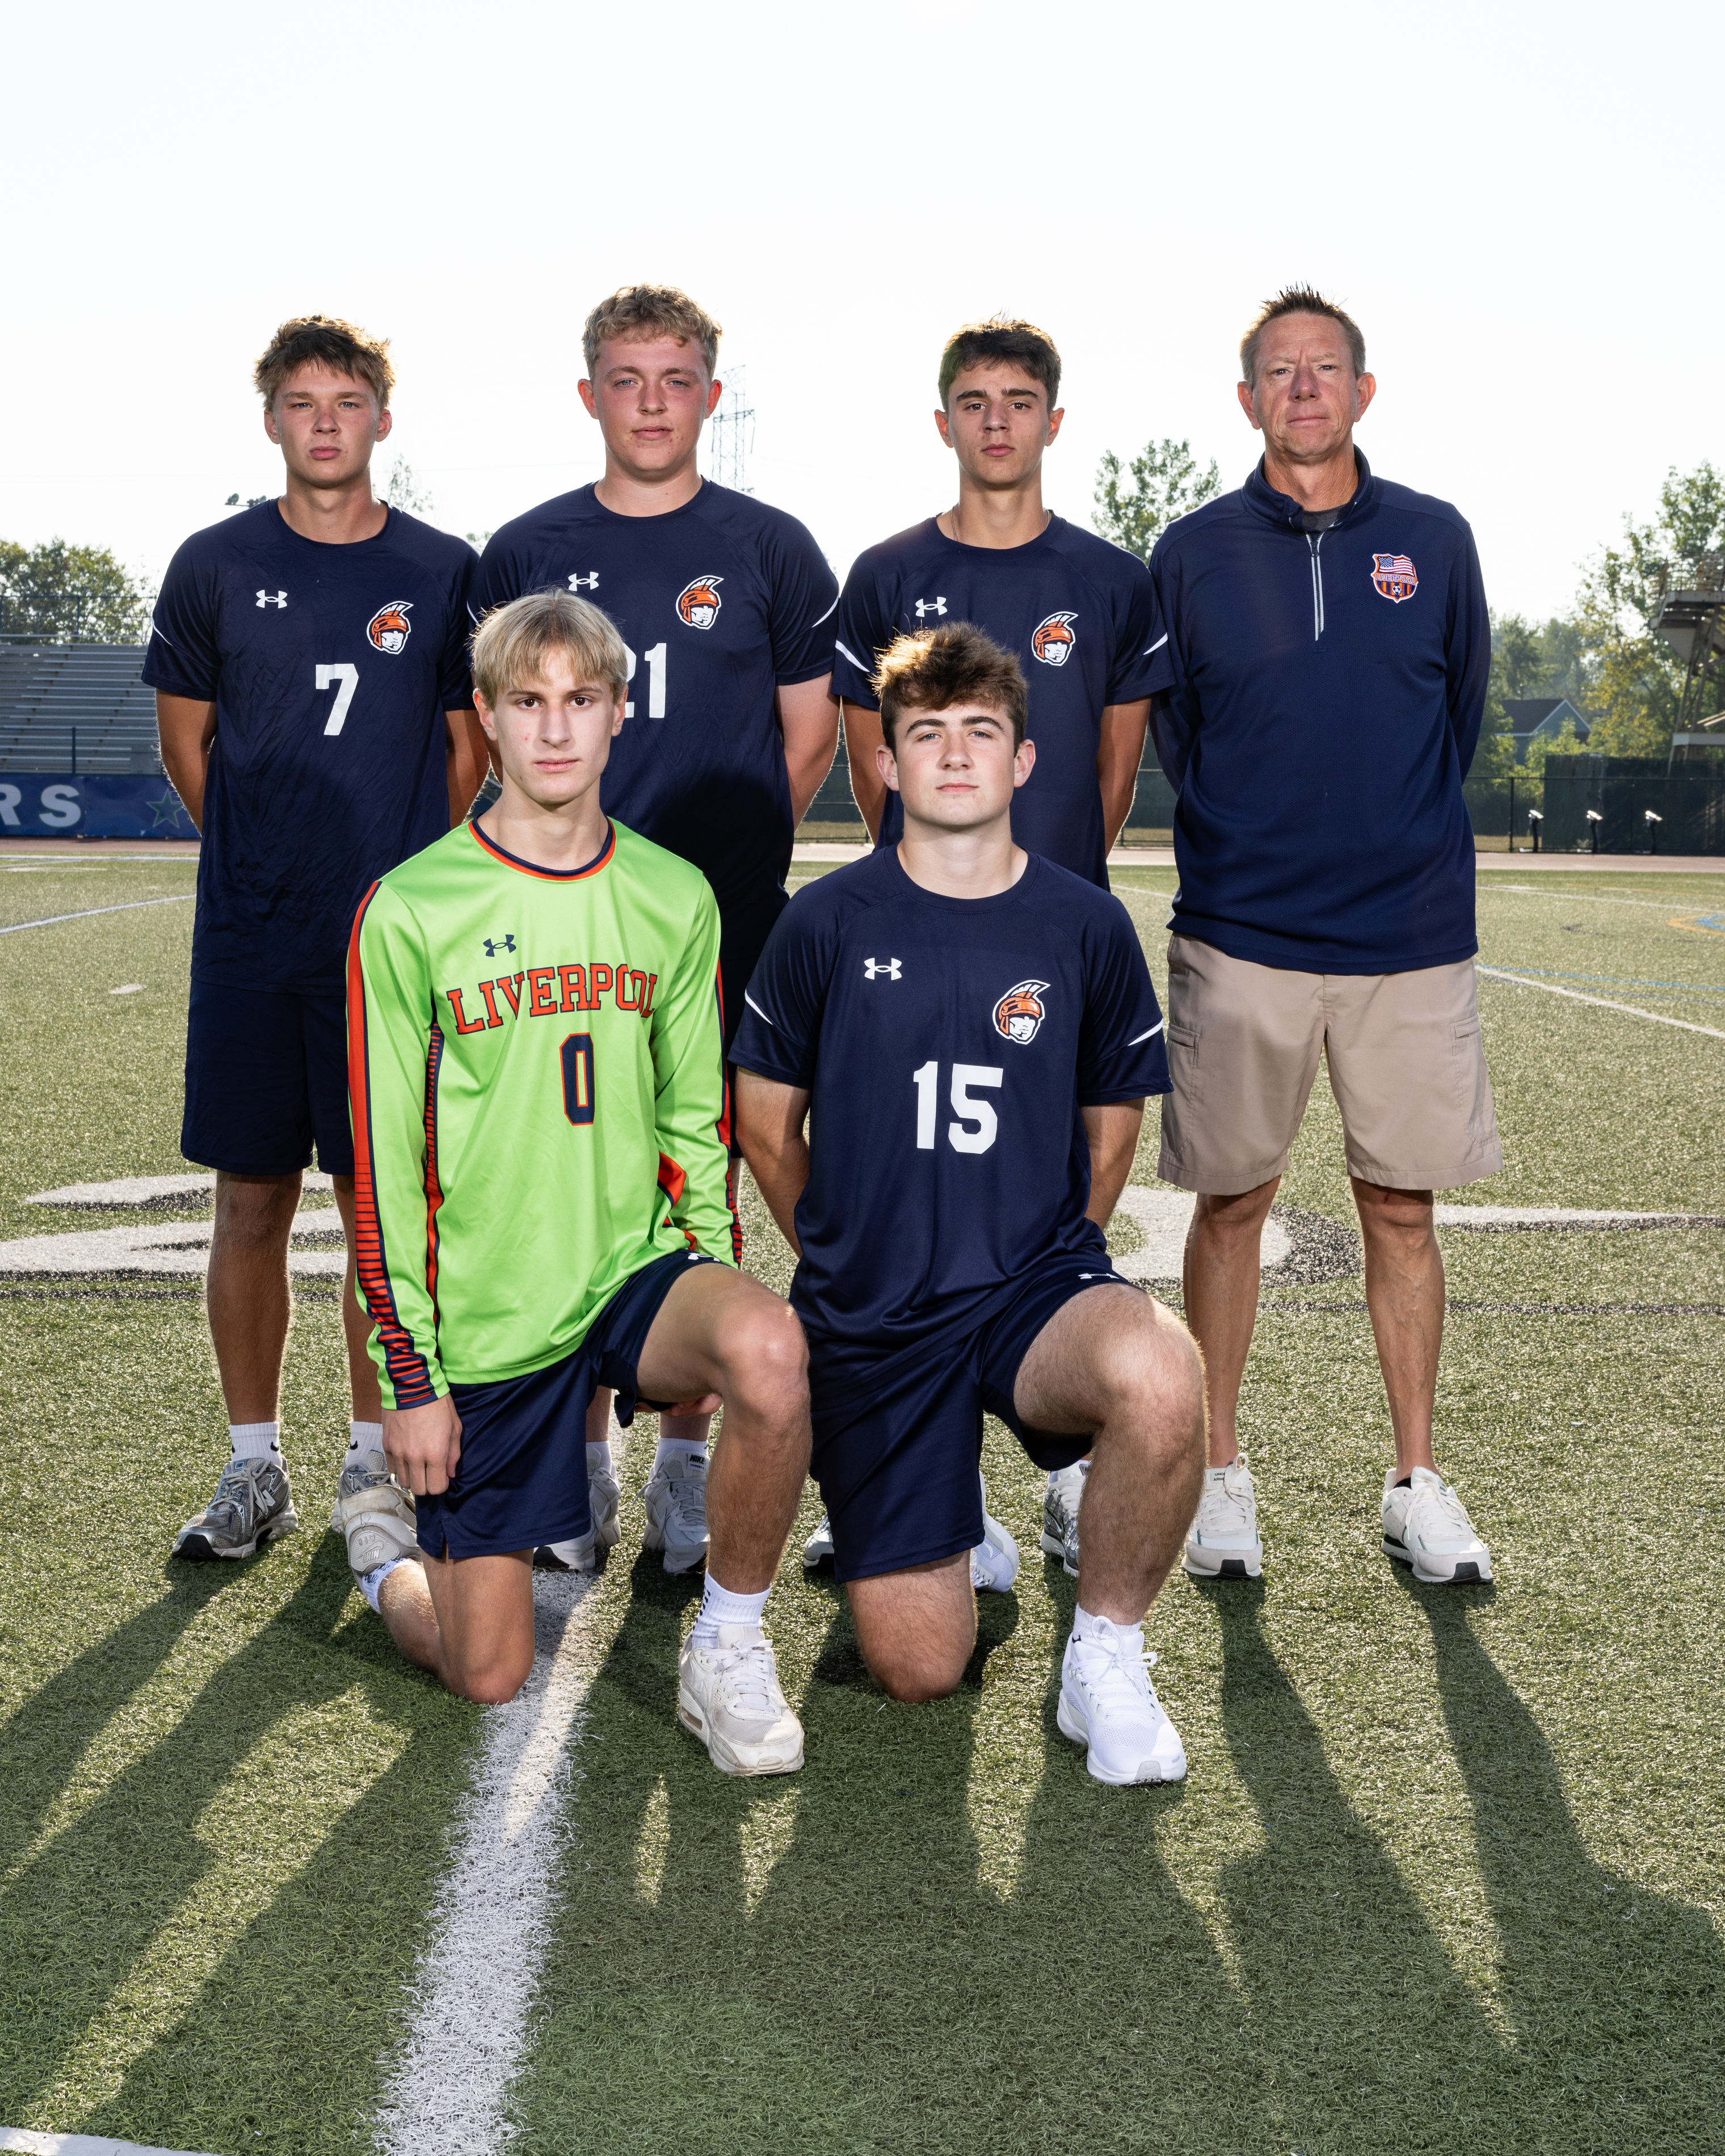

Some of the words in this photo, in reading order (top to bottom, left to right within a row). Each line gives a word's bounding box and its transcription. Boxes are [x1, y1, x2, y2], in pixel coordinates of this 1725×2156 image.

[1375, 572, 1416, 585] LIVERPOOL
[315, 663, 359, 736] 7
[623, 643, 667, 718] 1
[446, 963, 658, 1035] LIVERPOOL
[559, 1032, 595, 1126] 0
[913, 1061, 1003, 1154] 15
[689, 1454, 705, 1464] NIKE
[357, 1534, 376, 1546] AIR
[362, 1549, 380, 1563] NIKE
